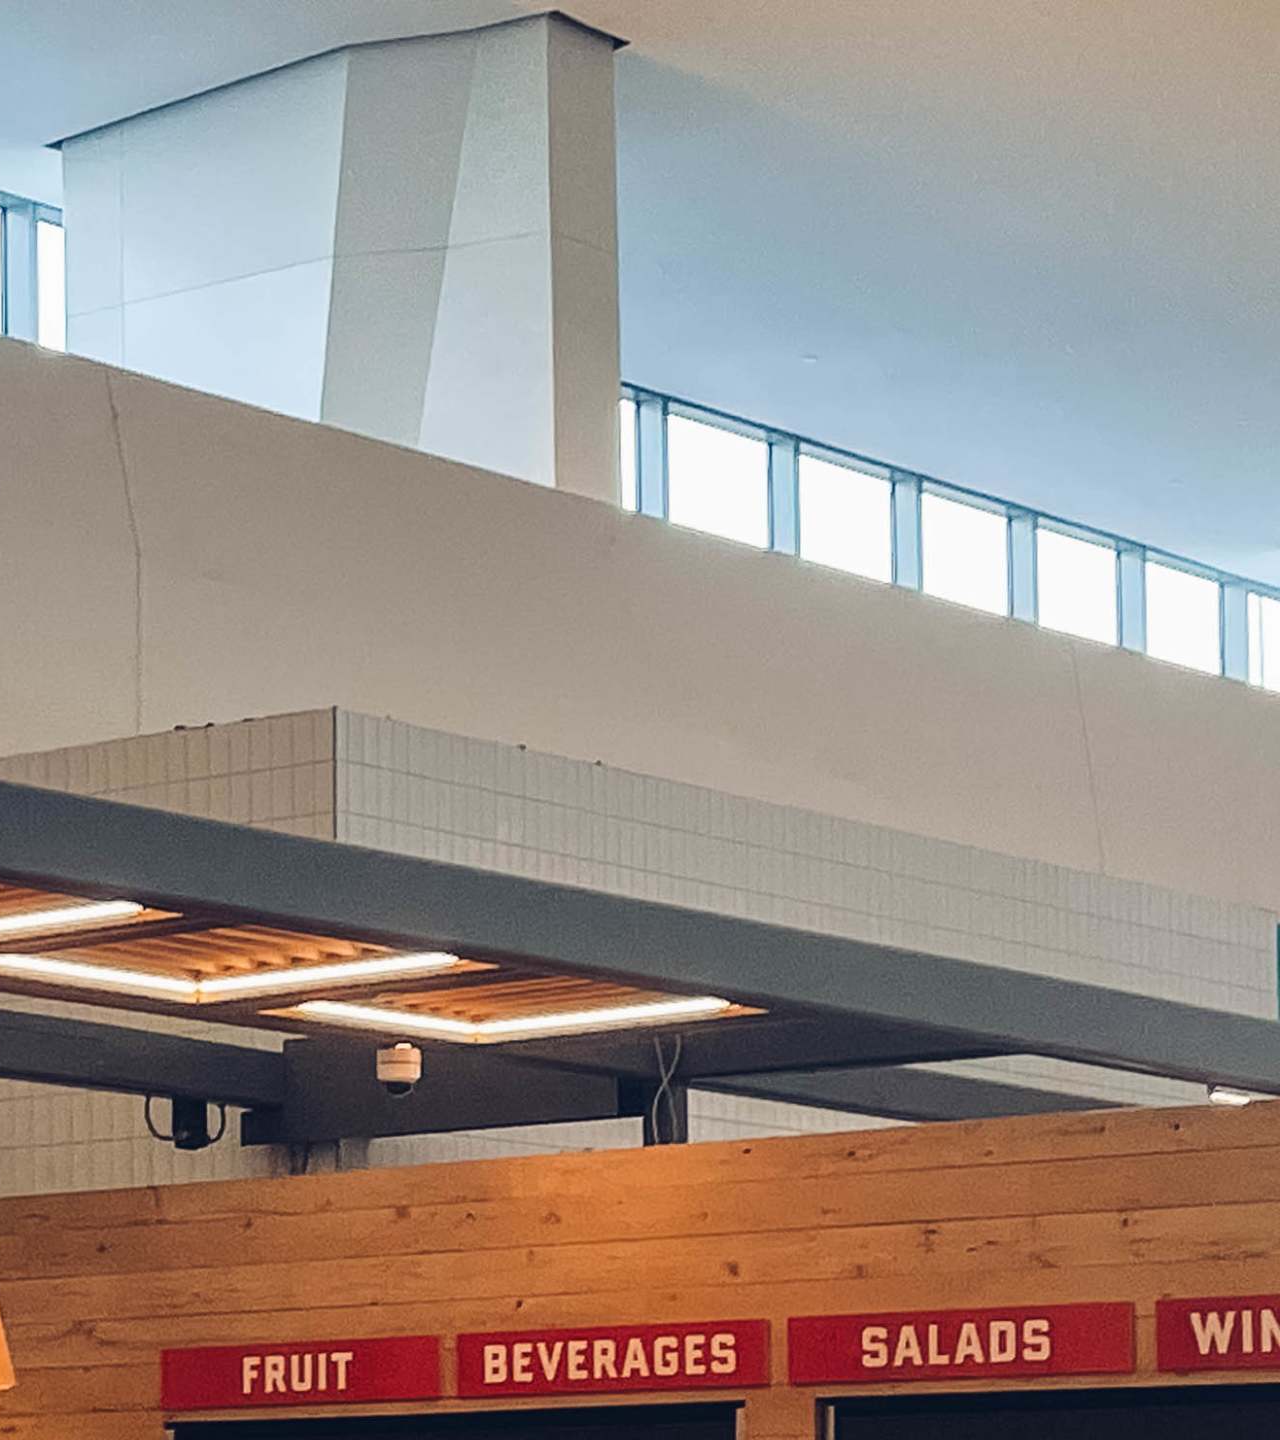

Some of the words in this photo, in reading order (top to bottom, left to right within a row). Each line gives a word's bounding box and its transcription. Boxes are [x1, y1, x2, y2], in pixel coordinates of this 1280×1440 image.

[483, 1333, 738, 1384] BEVERAGES
[861, 1318, 1052, 1369] SALADS
[242, 1351, 354, 1394] FRUIT
